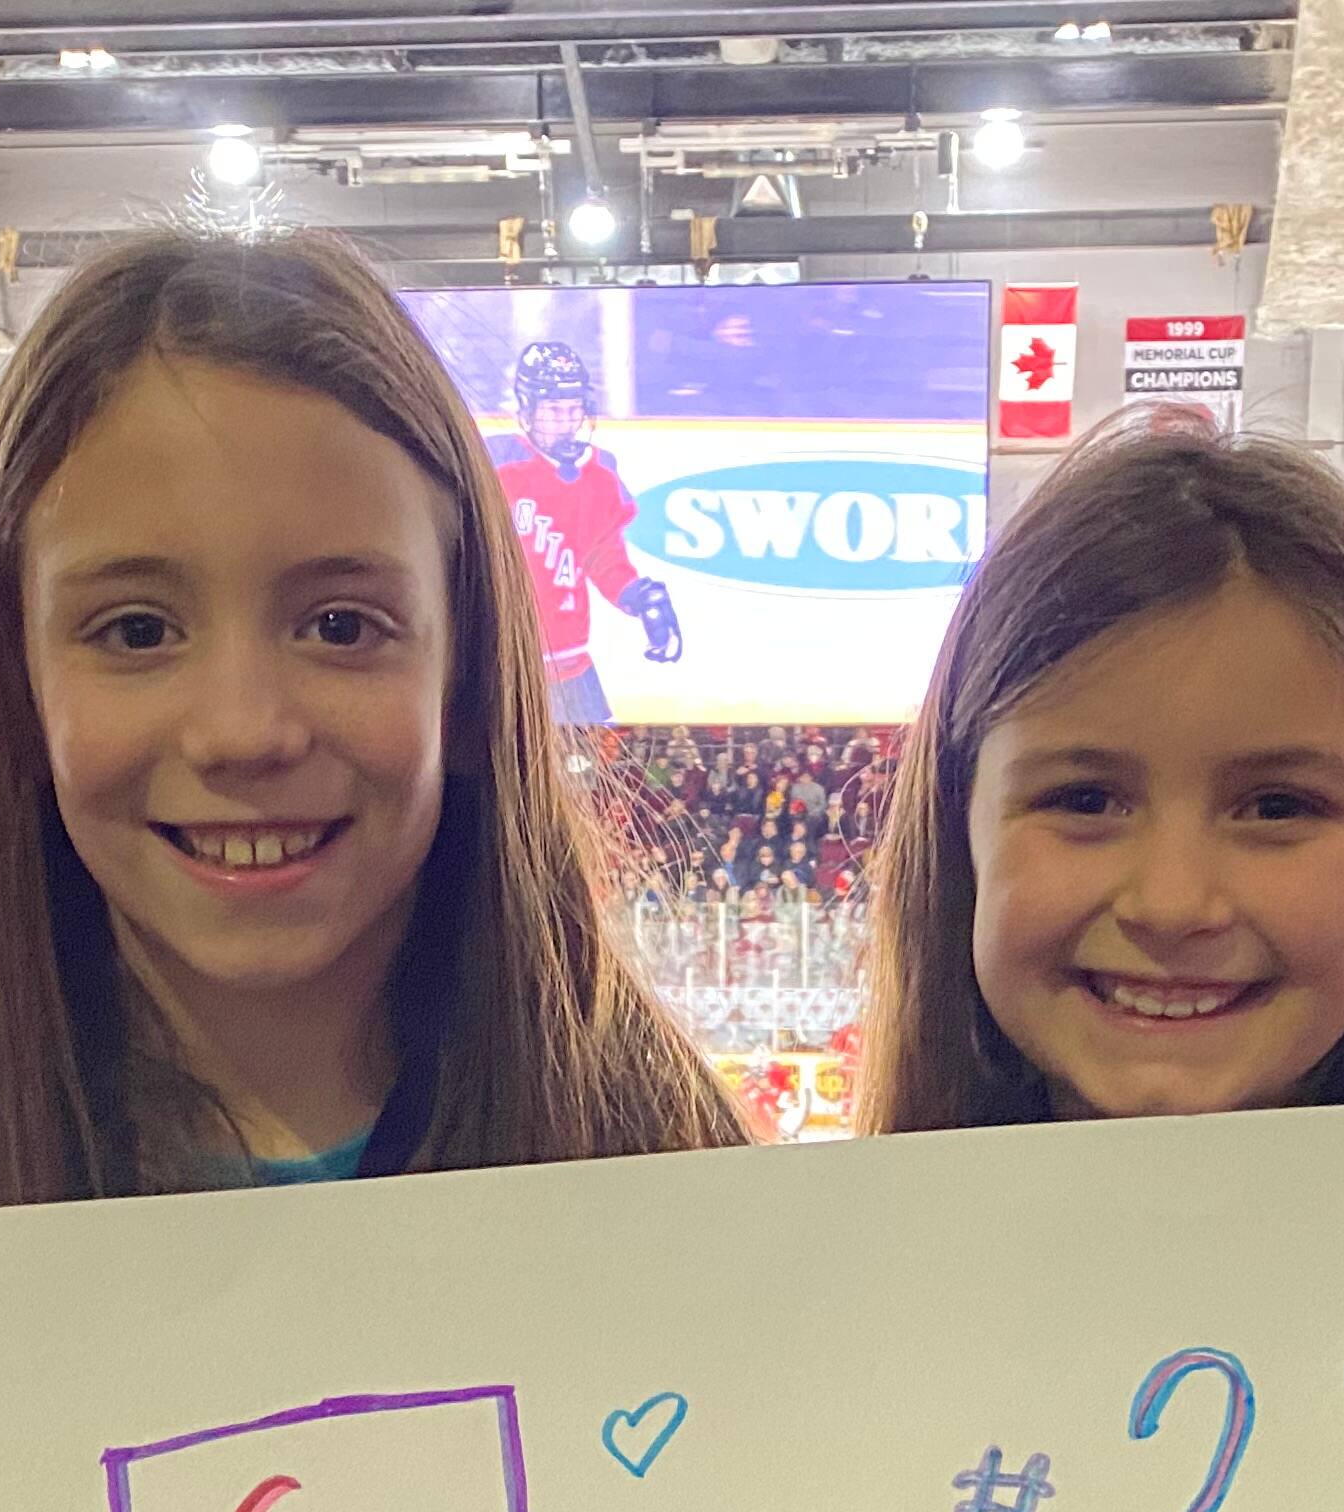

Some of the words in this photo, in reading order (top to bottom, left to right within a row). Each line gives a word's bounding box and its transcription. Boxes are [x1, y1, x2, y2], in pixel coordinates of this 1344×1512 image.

[1166, 321, 1205, 337] 1999
[1133, 347, 1205, 361] MEMORIAL
[1208, 346, 1236, 360] CUP
[1130, 371, 1238, 388] CHAMPIONS
